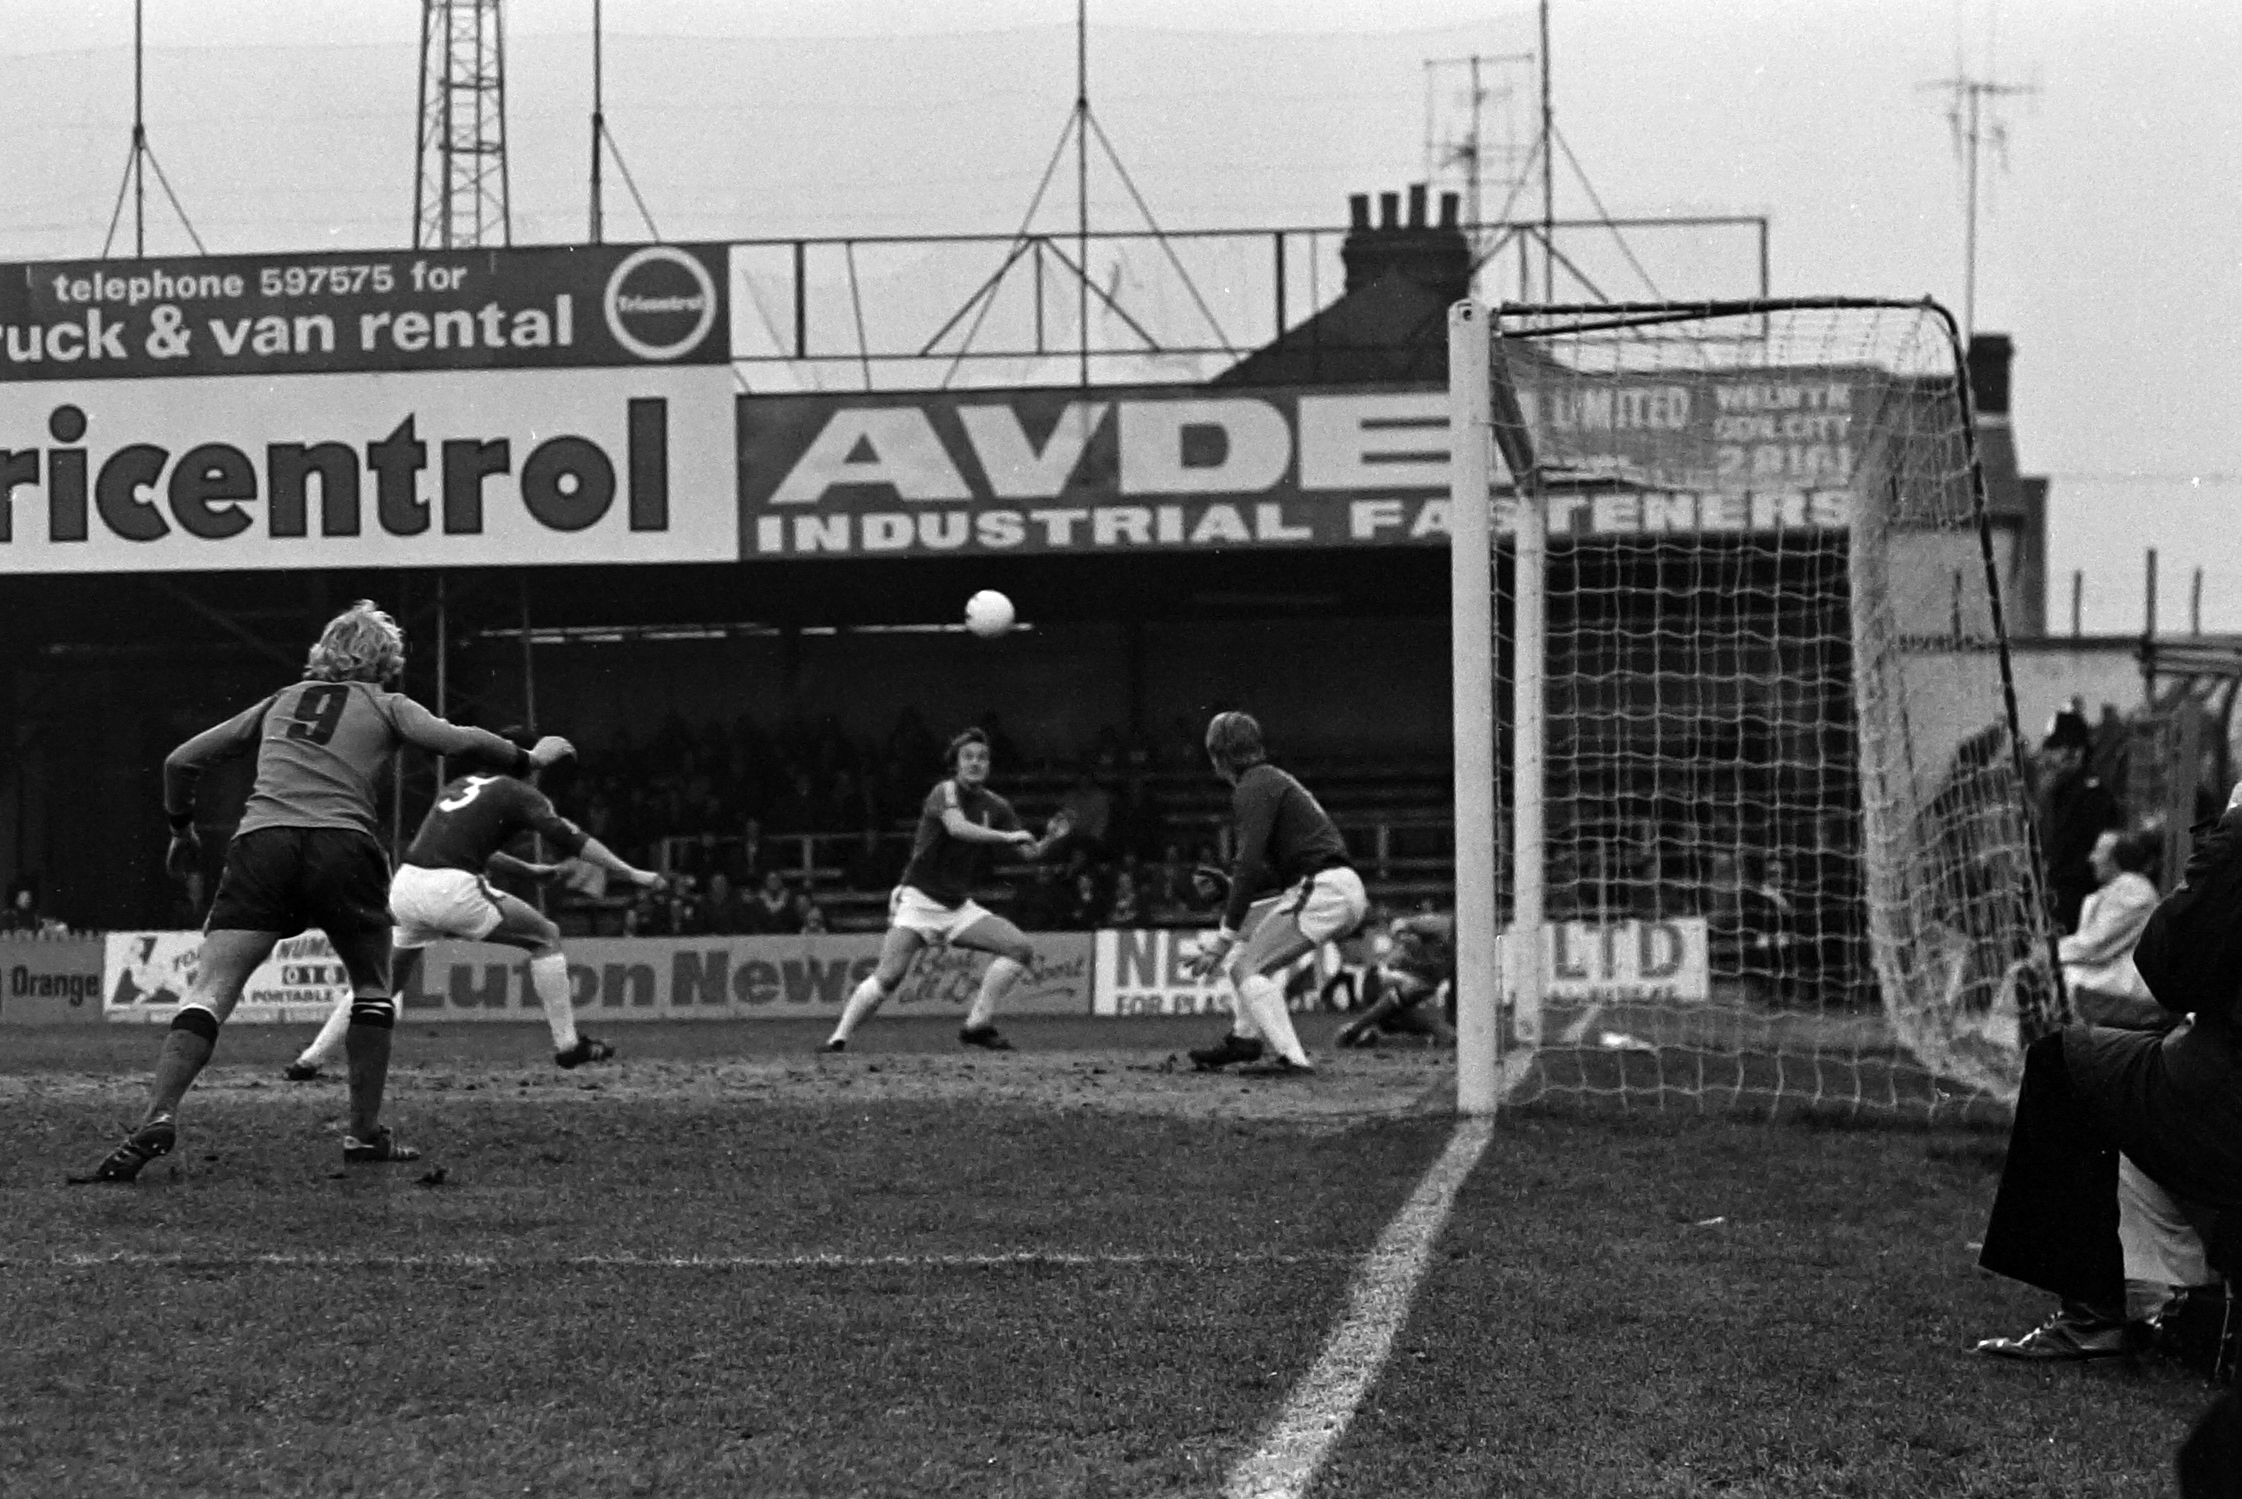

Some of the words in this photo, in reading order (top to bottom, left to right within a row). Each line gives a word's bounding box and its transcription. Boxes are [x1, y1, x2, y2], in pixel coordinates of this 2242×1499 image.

[53, 268, 244, 306] telephone
[260, 265, 395, 297] 597575
[411, 260, 468, 292] for
[0, 307, 129, 362] uck
[145, 304, 191, 359] &
[208, 314, 335, 356] van
[360, 294, 573, 351] rental
[757, 504, 1313, 554] INDUSTRIAL
[286, 684, 349, 746] 9
[439, 775, 500, 812] 3
[1553, 922, 1686, 980] LTD
[11, 964, 99, 1007] Orange
